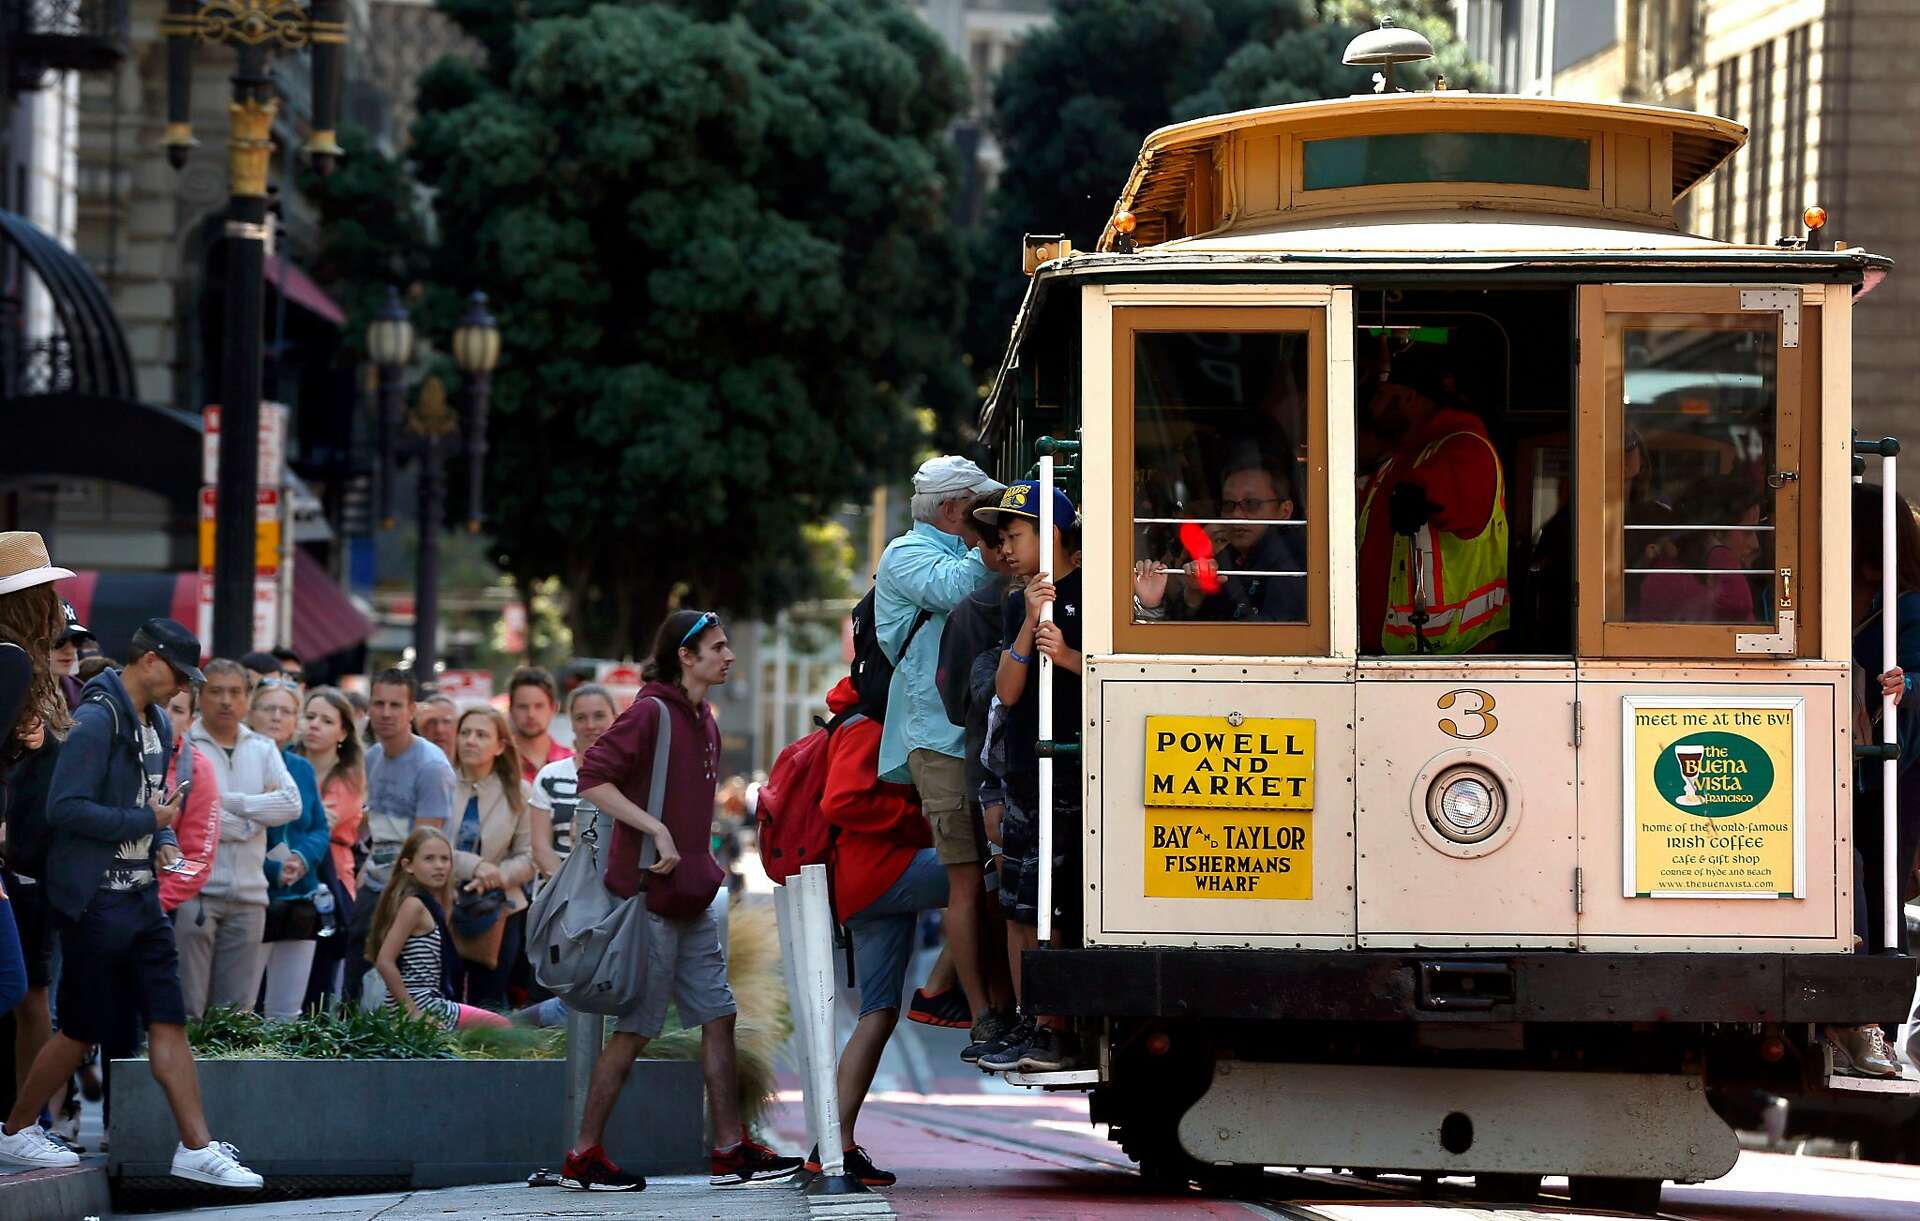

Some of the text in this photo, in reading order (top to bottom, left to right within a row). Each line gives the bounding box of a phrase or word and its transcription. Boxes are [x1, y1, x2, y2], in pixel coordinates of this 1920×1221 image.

[1437, 688, 1498, 740] 3
[1735, 711, 1763, 726] the
[1157, 732, 1304, 755] POWELL
[1704, 745, 1729, 758] the
[1195, 757, 1269, 773] AND
[1684, 758, 1748, 774] Buena
[1153, 774, 1307, 797] MARKET
[1642, 823, 1673, 833] home
[1675, 823, 1688, 834] of
[1690, 822, 1710, 832] the
[1152, 825, 1193, 849] BAY
[1223, 825, 1306, 850] TAYLOR
[1164, 855, 1291, 873] FISHERMANS
[1698, 855, 1706, 864] &
[1694, 868, 1704, 877] of
[1195, 875, 1260, 892] WHARF
